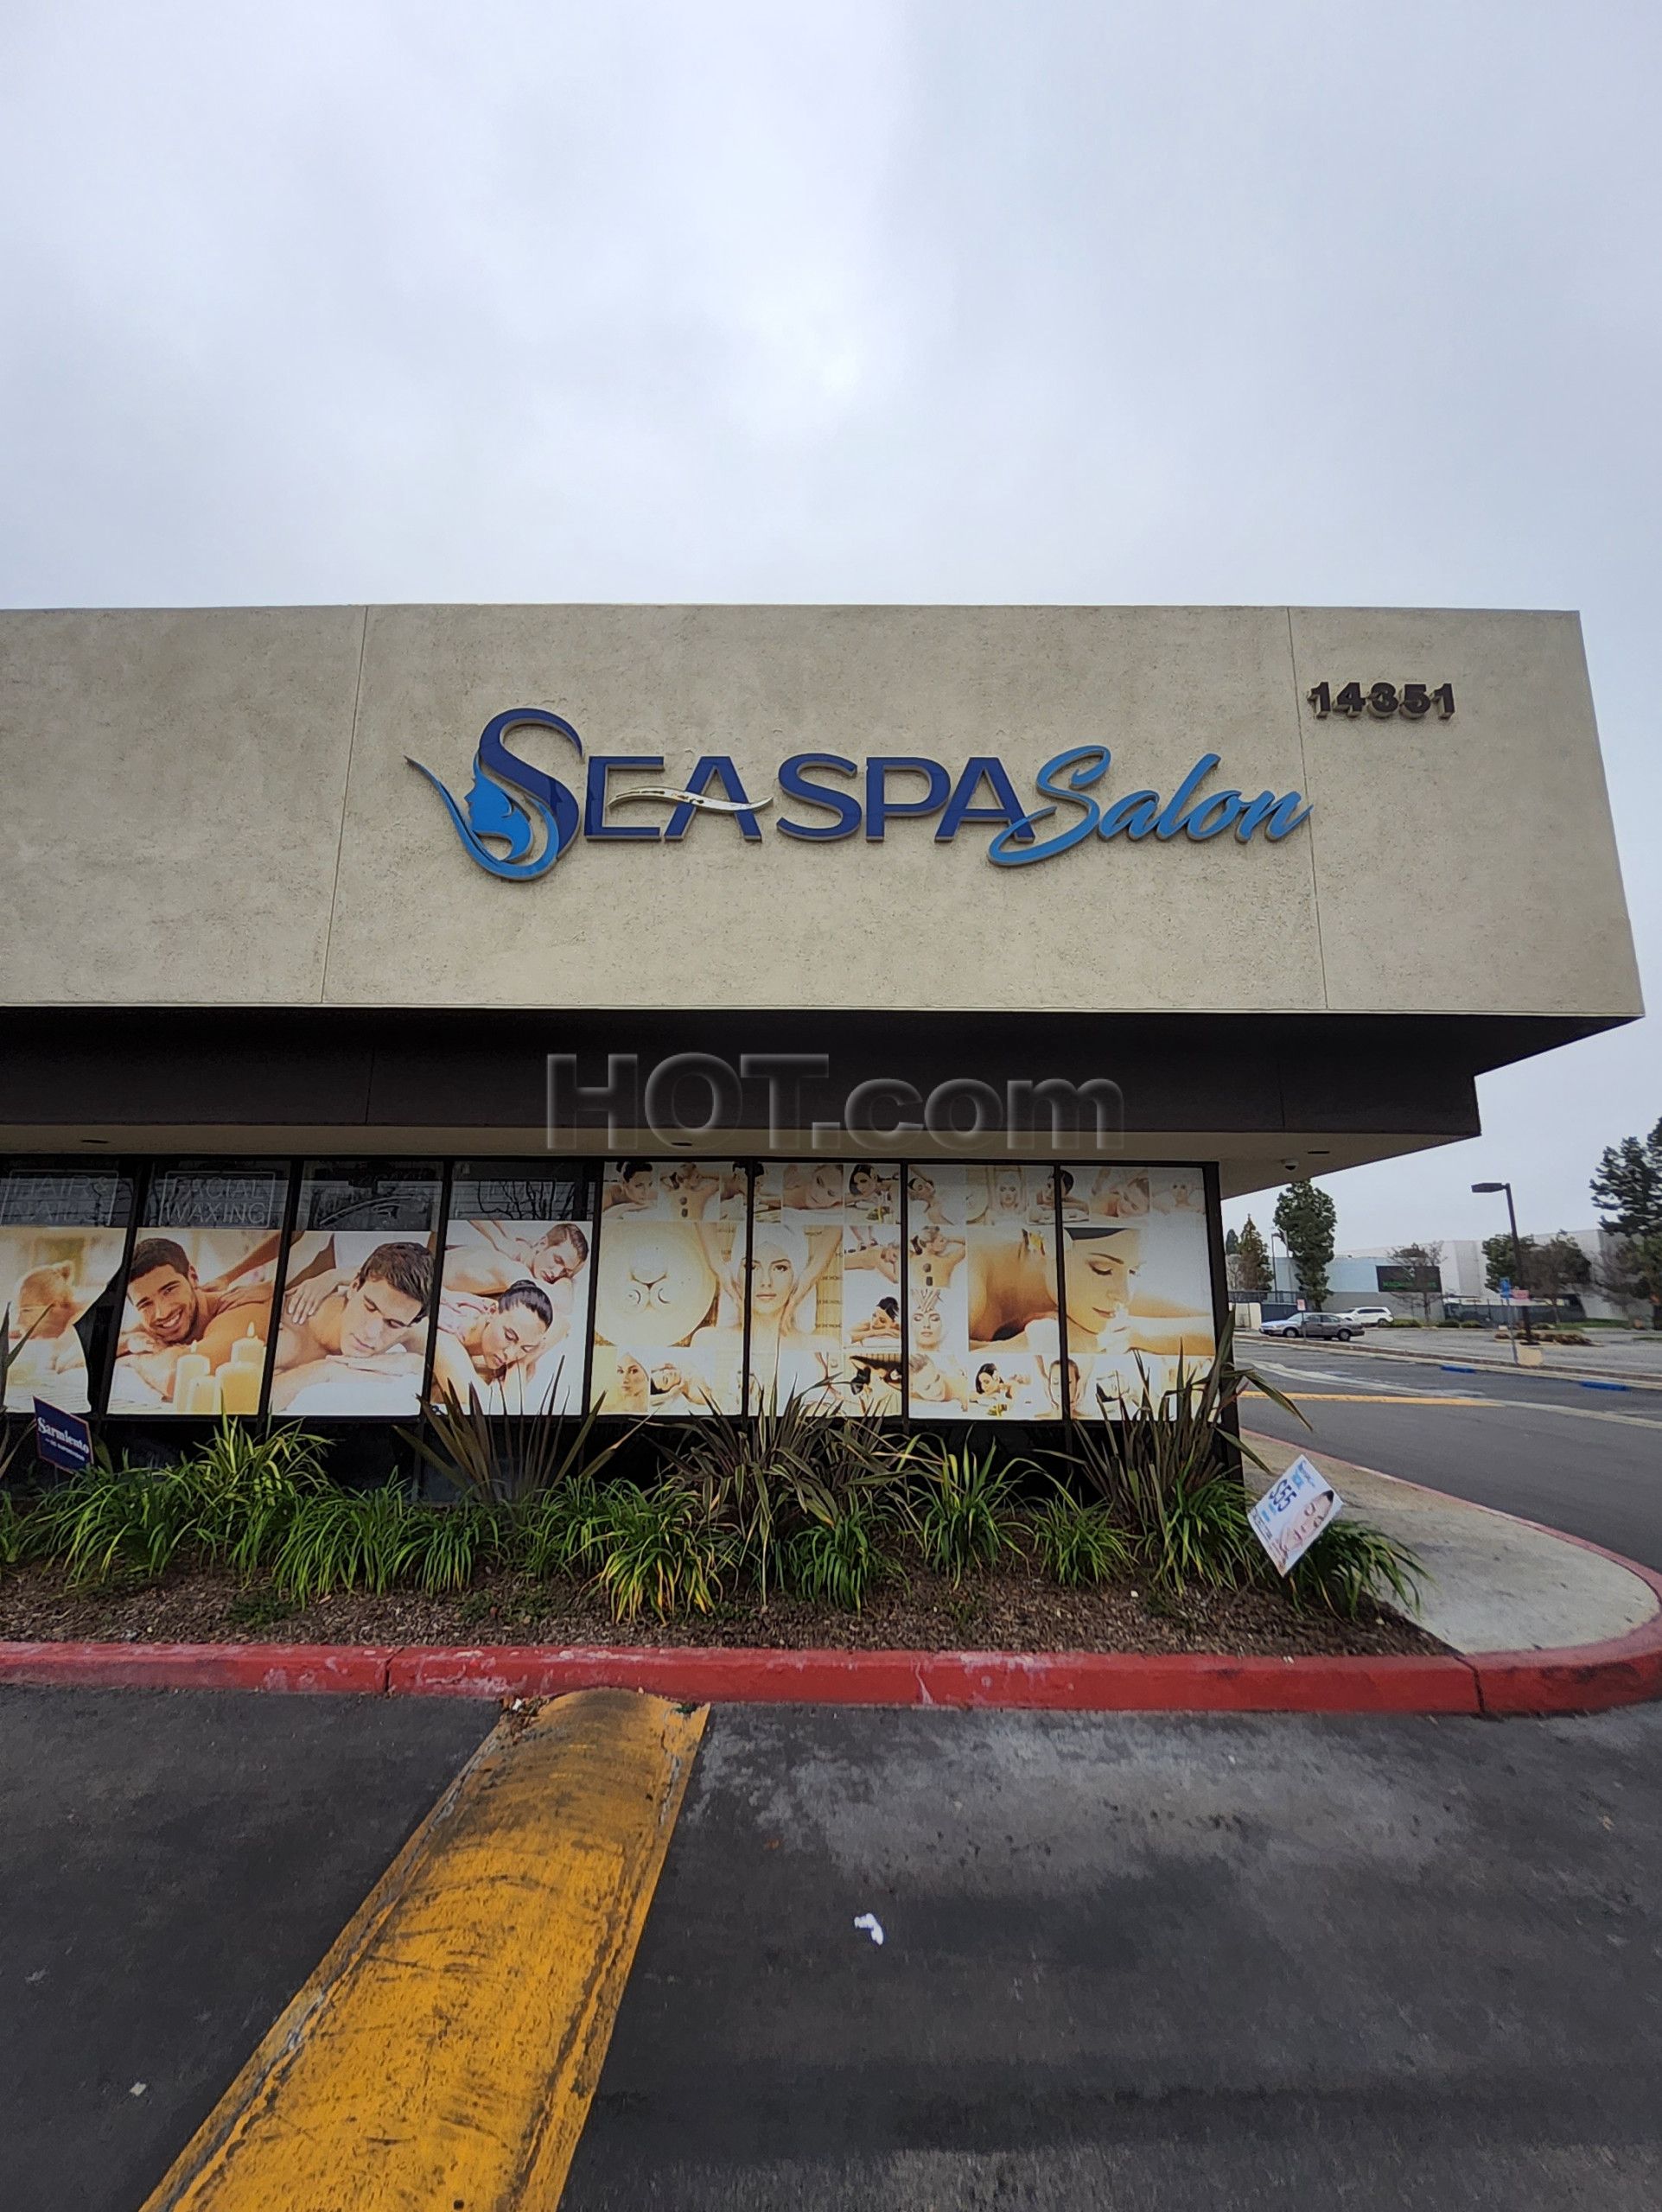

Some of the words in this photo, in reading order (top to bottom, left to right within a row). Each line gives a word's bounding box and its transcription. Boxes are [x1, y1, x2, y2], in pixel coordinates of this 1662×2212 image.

[1307, 681, 1455, 721] 14351
[404, 707, 1035, 881] SEASPA
[987, 744, 1314, 867] Salon
[164, 1201, 266, 1224] WAXING
[37, 1417, 90, 1453] Sarmiento
[1269, 1478, 1297, 1513] $55
